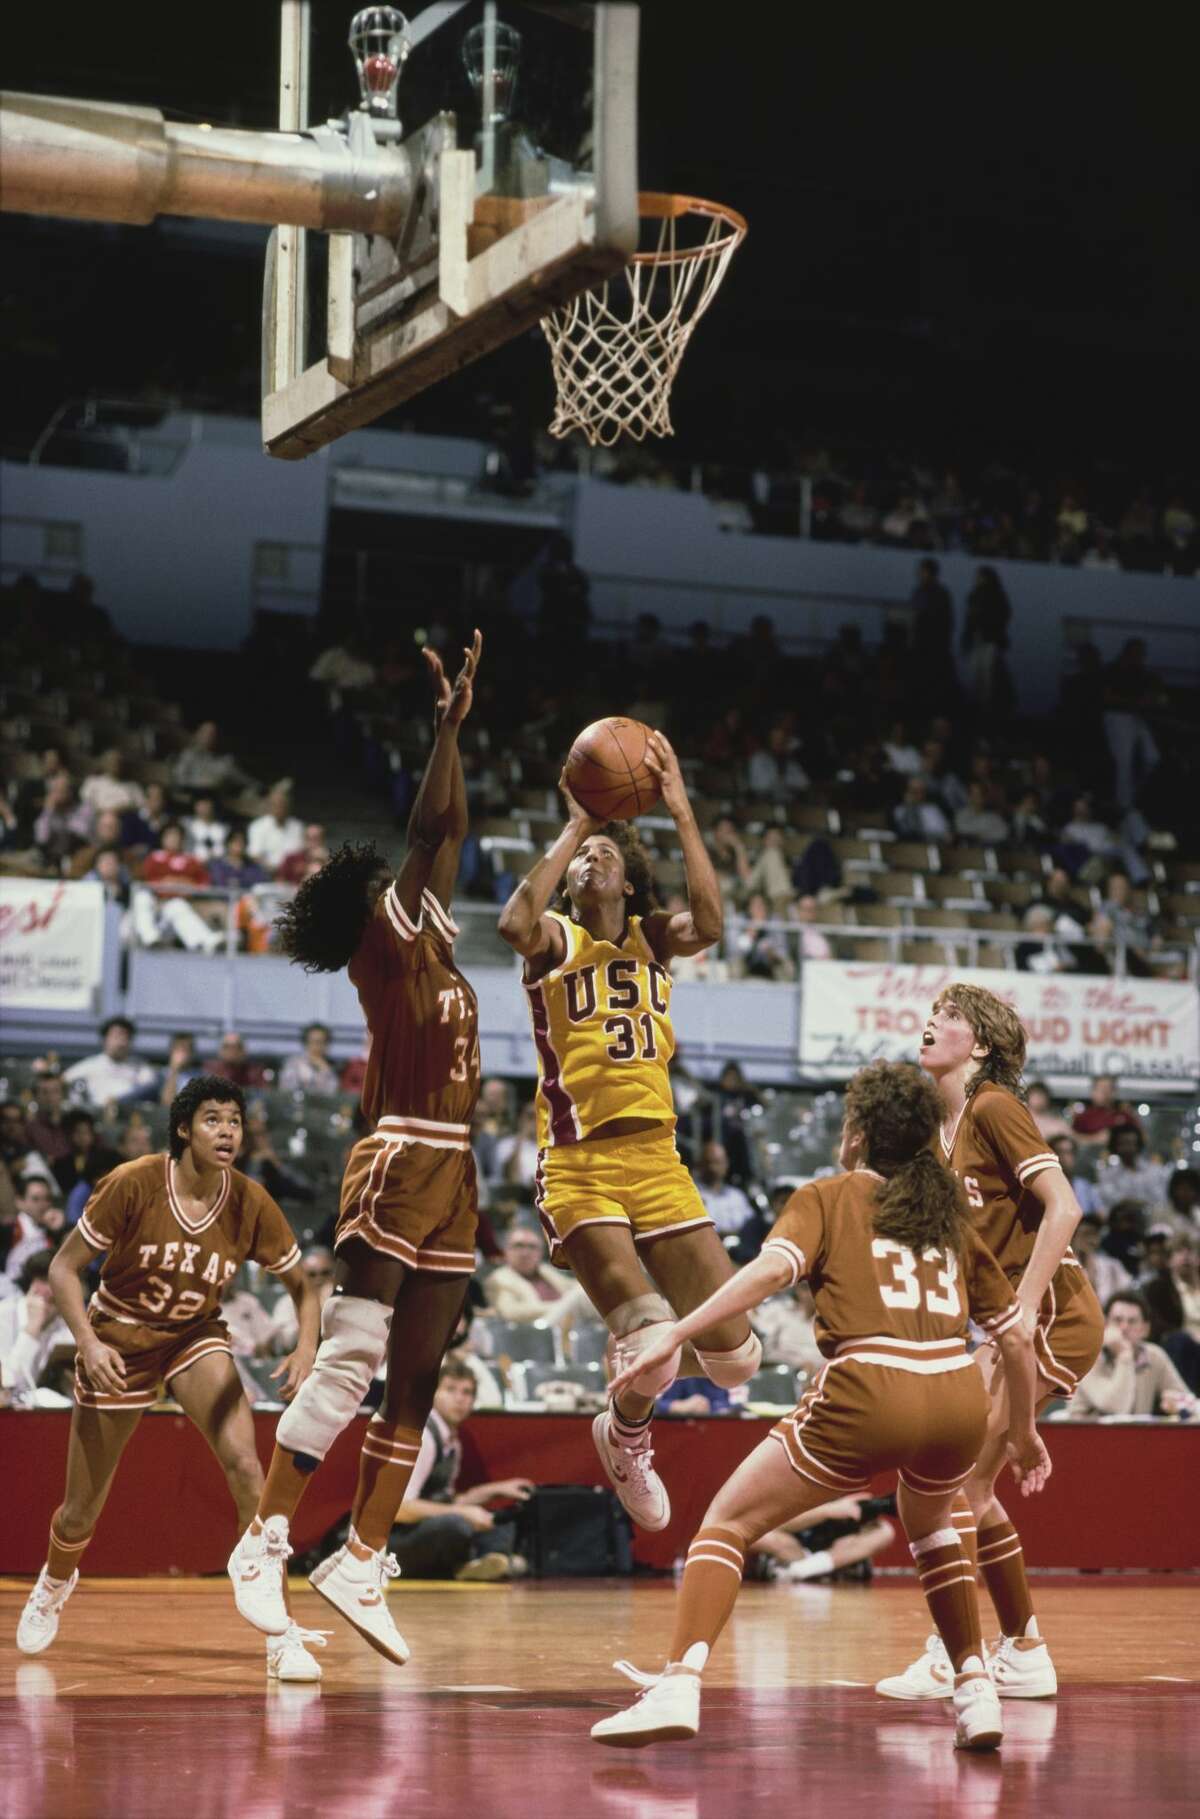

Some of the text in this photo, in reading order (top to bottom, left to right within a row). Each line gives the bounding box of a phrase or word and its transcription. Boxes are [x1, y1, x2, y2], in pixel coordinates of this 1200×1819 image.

[562, 959, 673, 1024] USC
[603, 1013, 658, 1062] 31
[1025, 1015, 1071, 1044] UD
[1082, 1019, 1172, 1048] LIGHT
[139, 1275, 206, 1320] 32
[871, 1238, 962, 1317] 33
